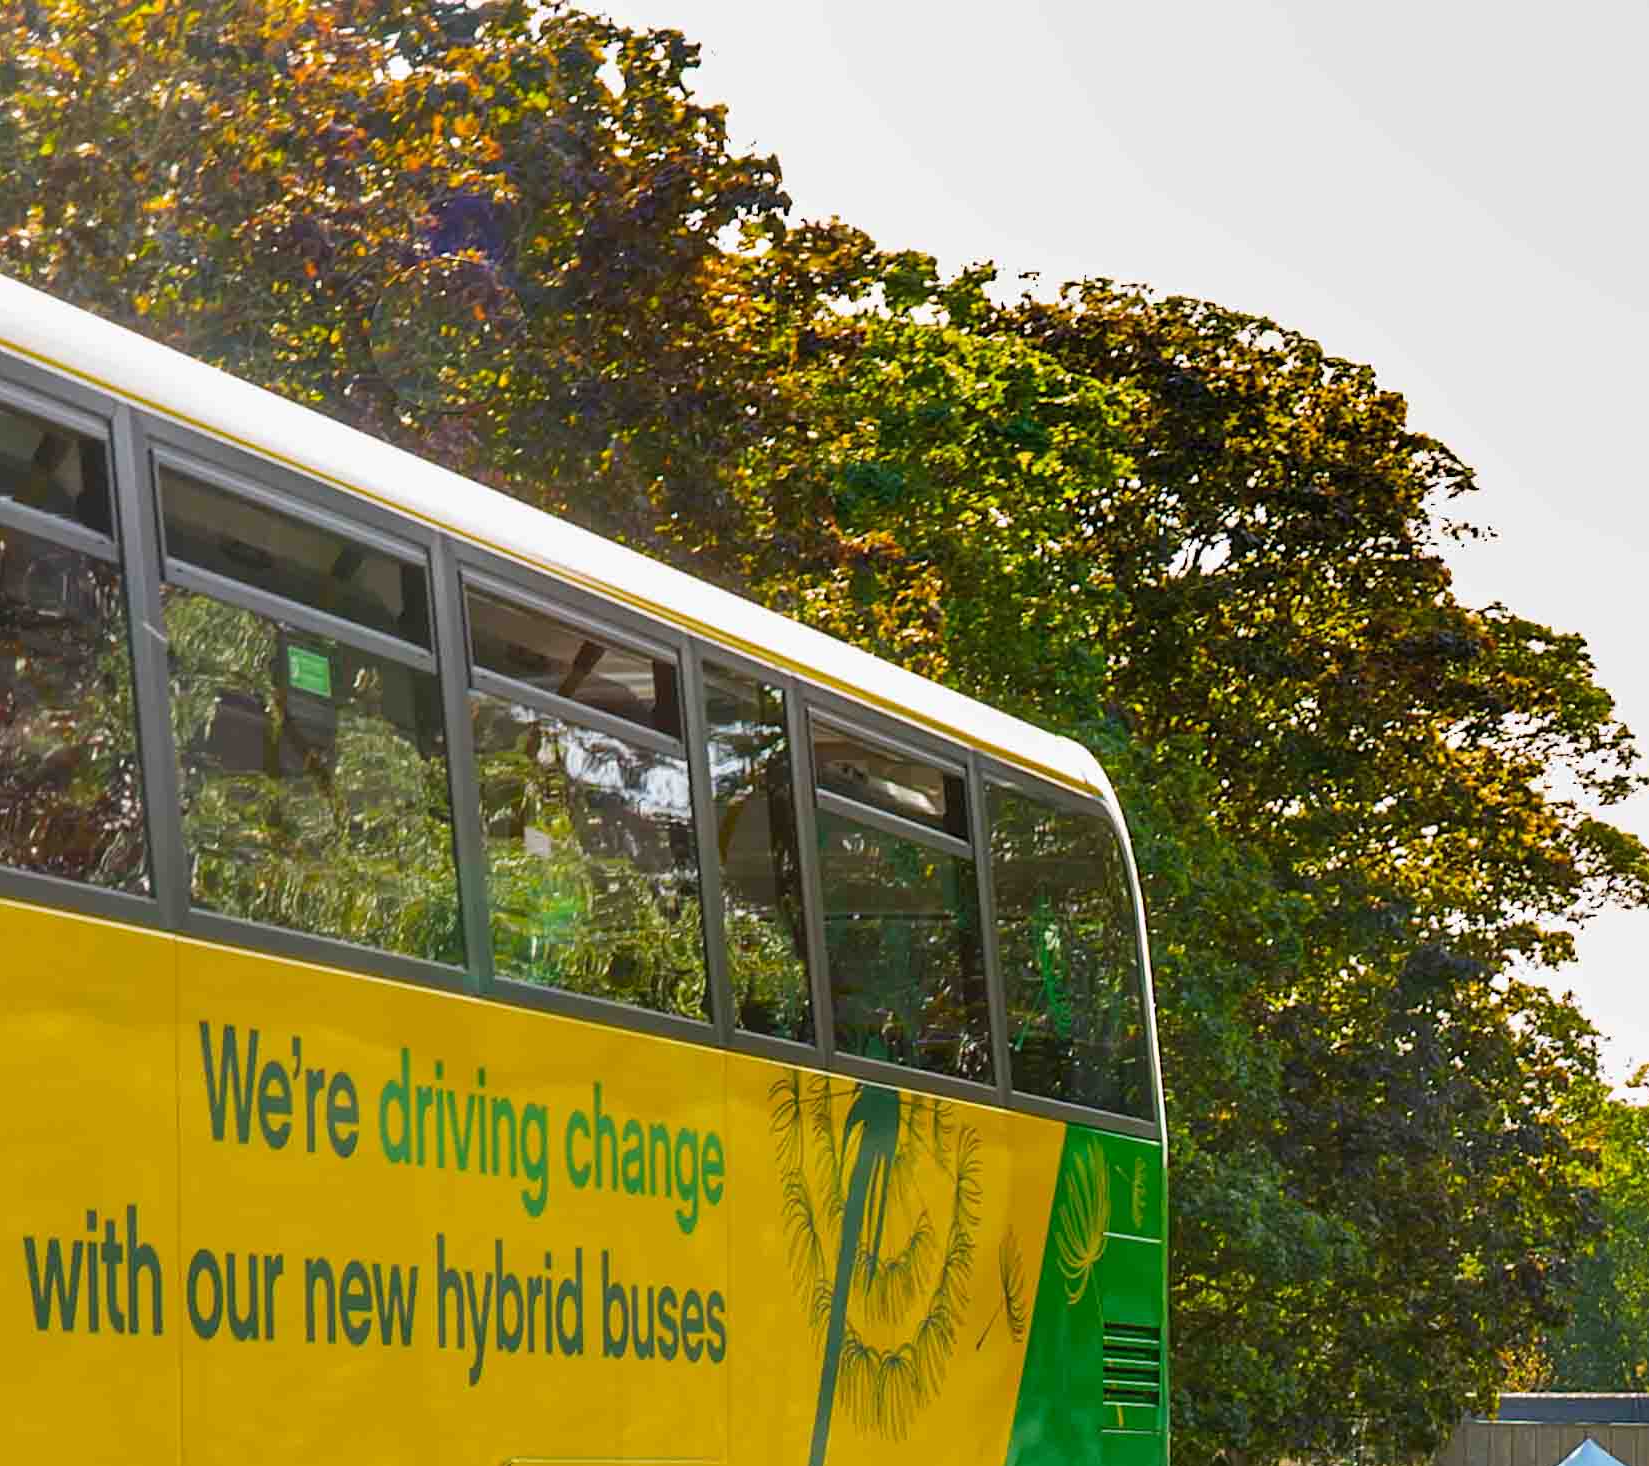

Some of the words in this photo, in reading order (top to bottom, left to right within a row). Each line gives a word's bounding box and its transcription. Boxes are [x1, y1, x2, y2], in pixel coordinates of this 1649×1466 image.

[198, 1020, 359, 1158] We’re
[379, 1048, 549, 1218] driving
[565, 1082, 725, 1234] change
[22, 1204, 163, 1336] with
[186, 1244, 284, 1342] our
[305, 1254, 419, 1347] new
[436, 1233, 583, 1386] hybrid
[602, 1249, 727, 1363] buses
